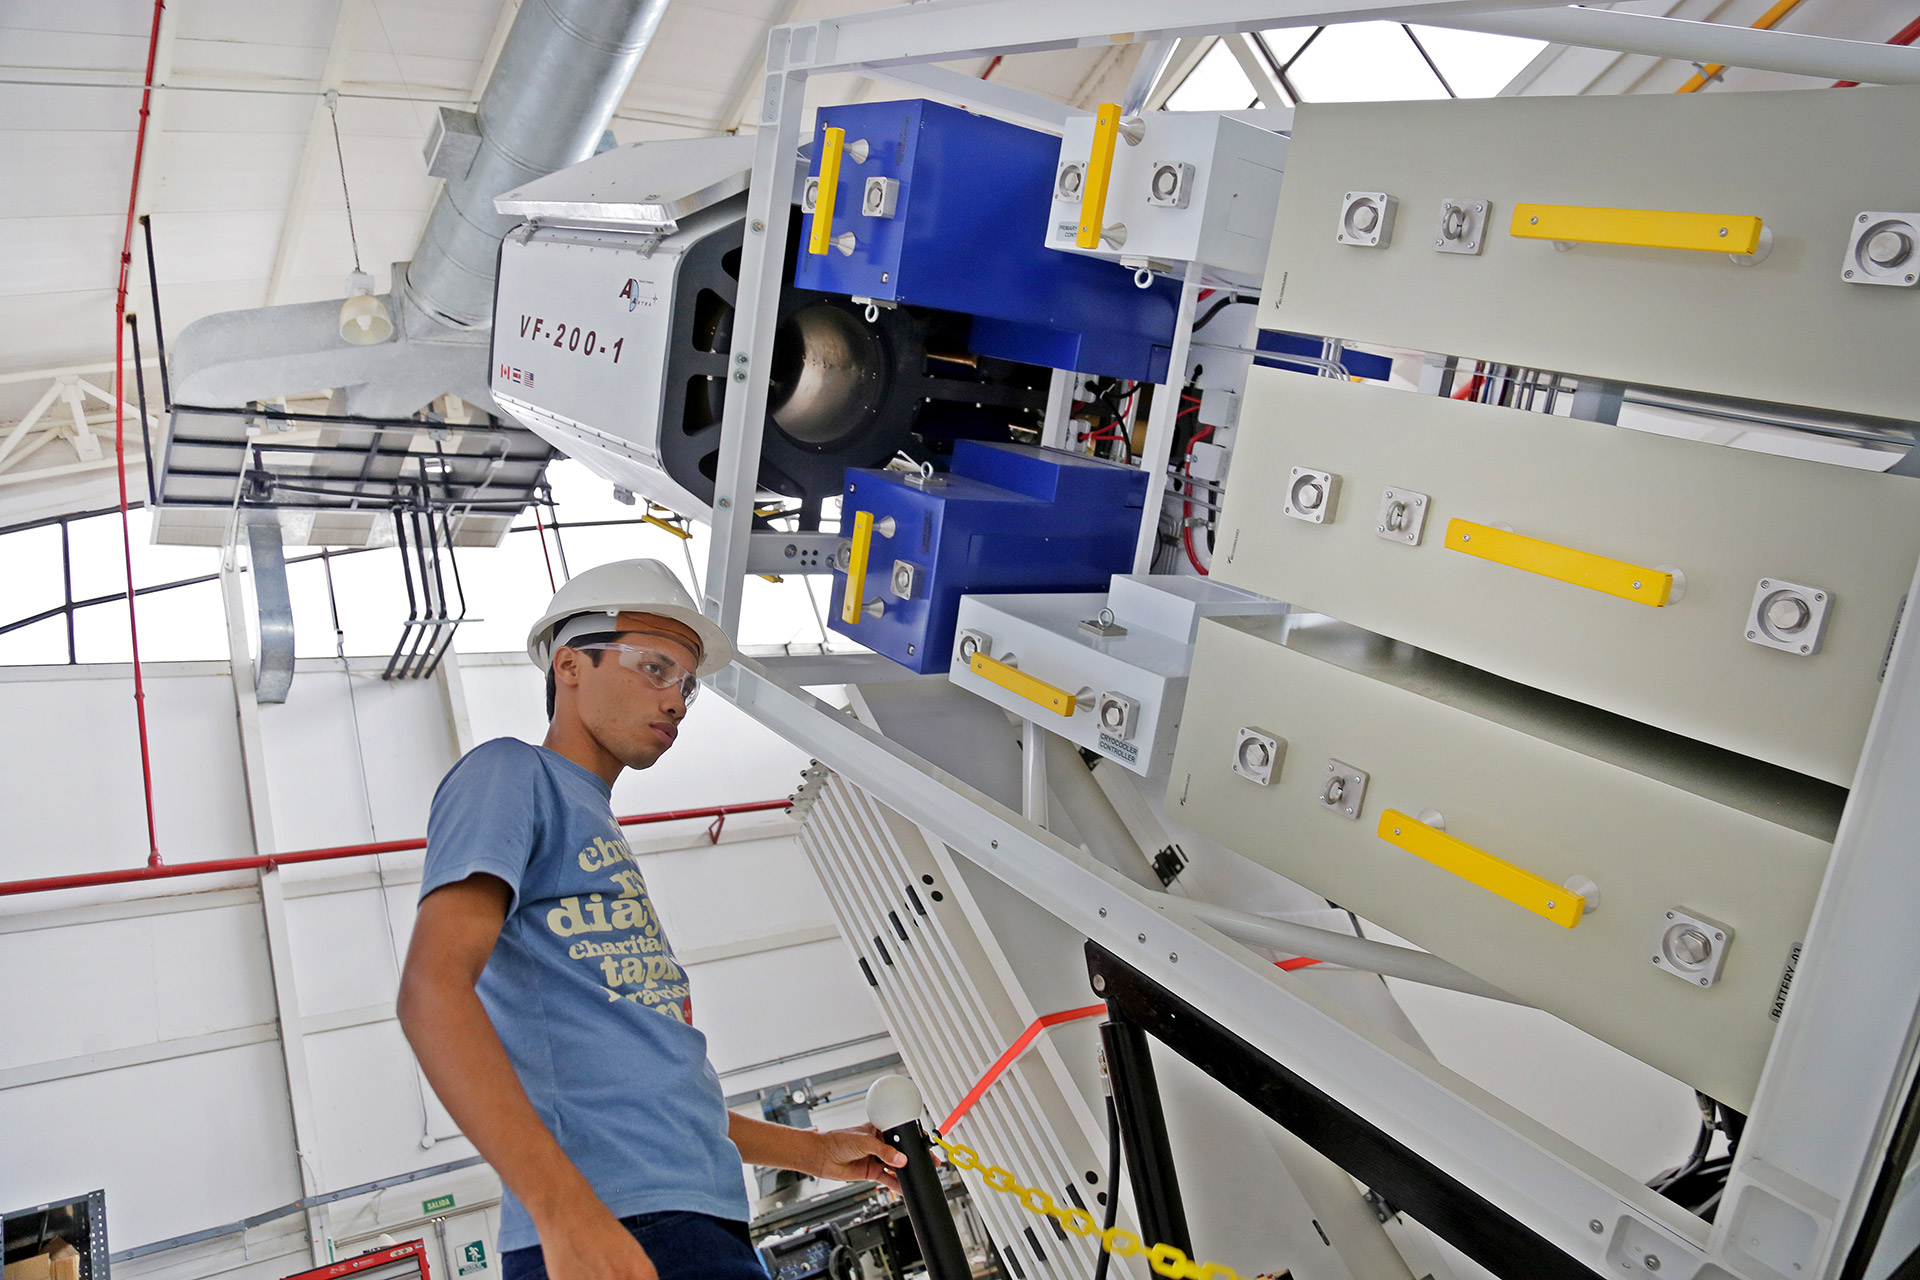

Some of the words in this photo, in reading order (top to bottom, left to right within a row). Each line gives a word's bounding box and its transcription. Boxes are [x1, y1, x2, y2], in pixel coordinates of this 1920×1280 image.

[520, 314, 624, 364] VF-200-1
[1099, 741, 1136, 764] CONTROLLER
[1771, 965, 1796, 1018] BATTERY
[427, 1198, 451, 1211] SALIDA
